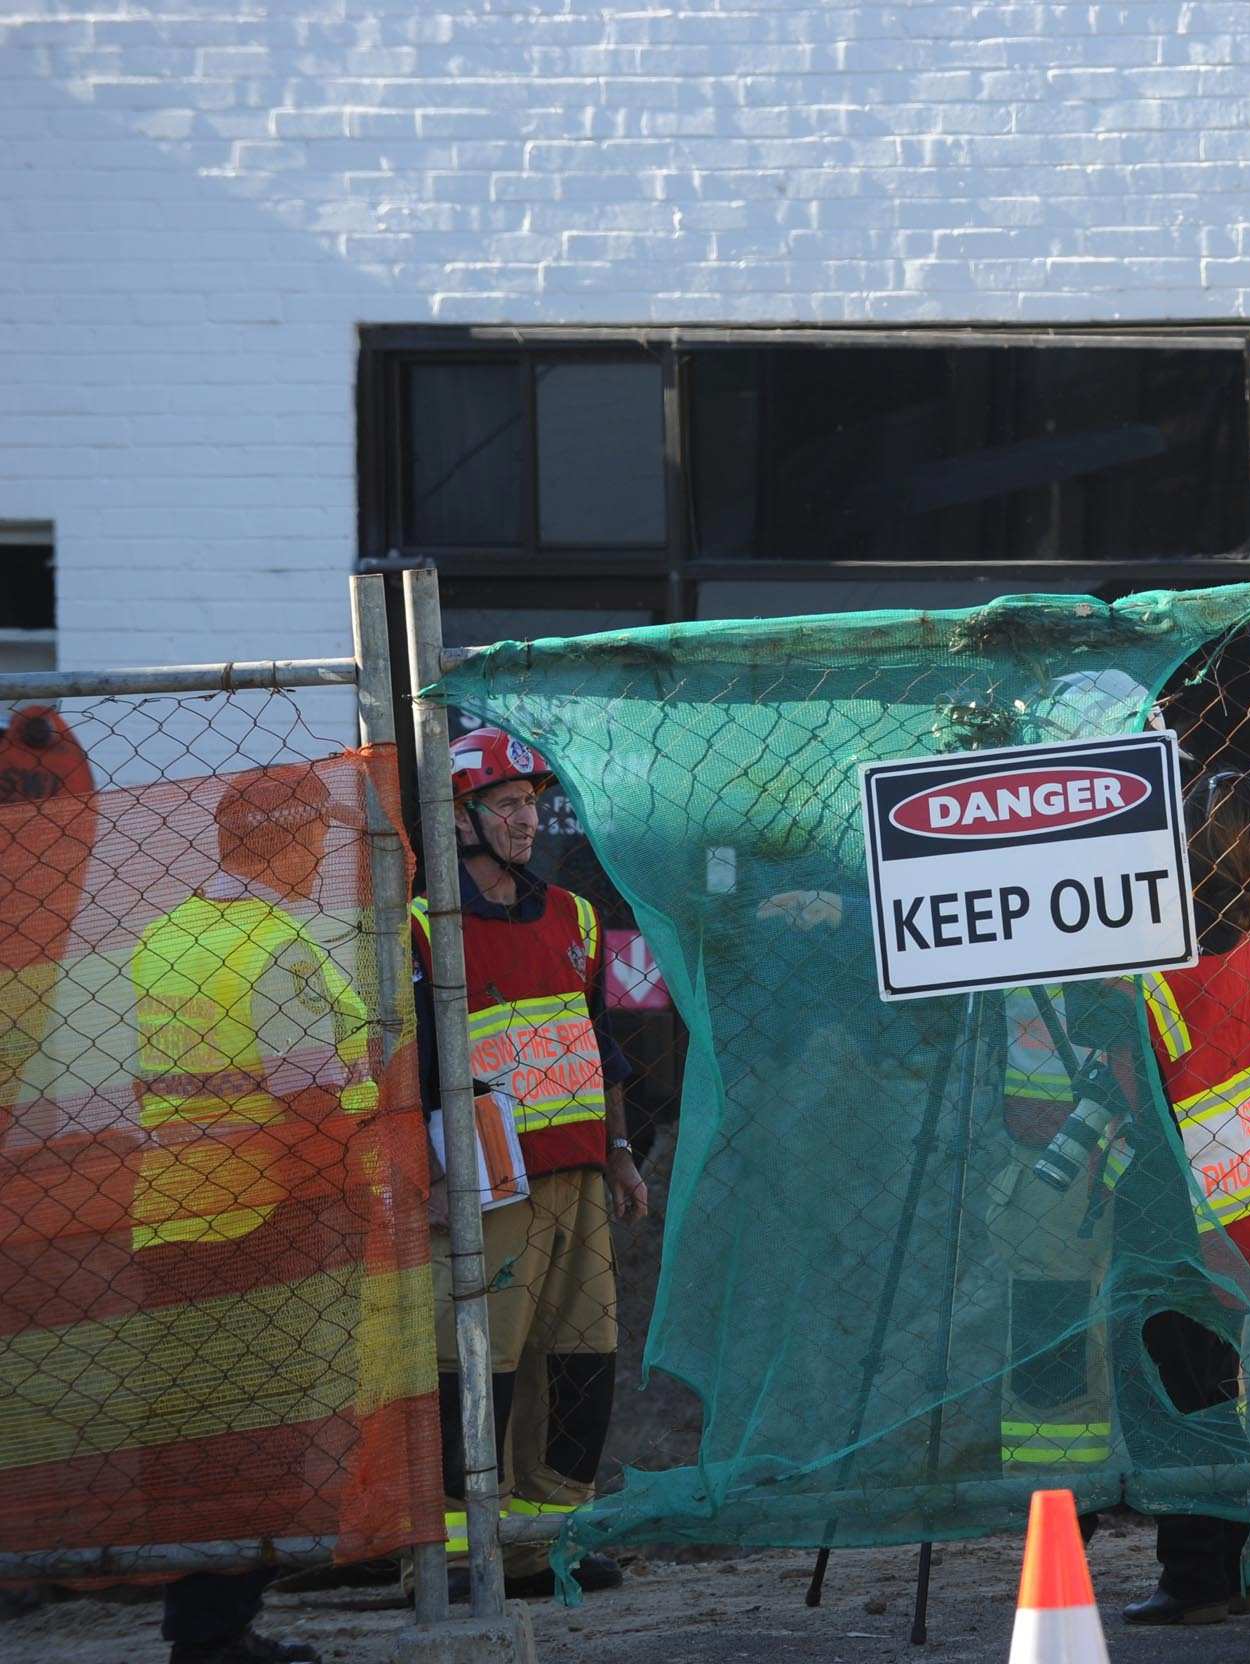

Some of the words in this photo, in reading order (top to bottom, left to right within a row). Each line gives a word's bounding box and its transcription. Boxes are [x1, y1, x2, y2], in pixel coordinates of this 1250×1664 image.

[928, 777, 1126, 828] DANGER
[893, 886, 1030, 952] KEEP
[1050, 869, 1169, 933] OUT
